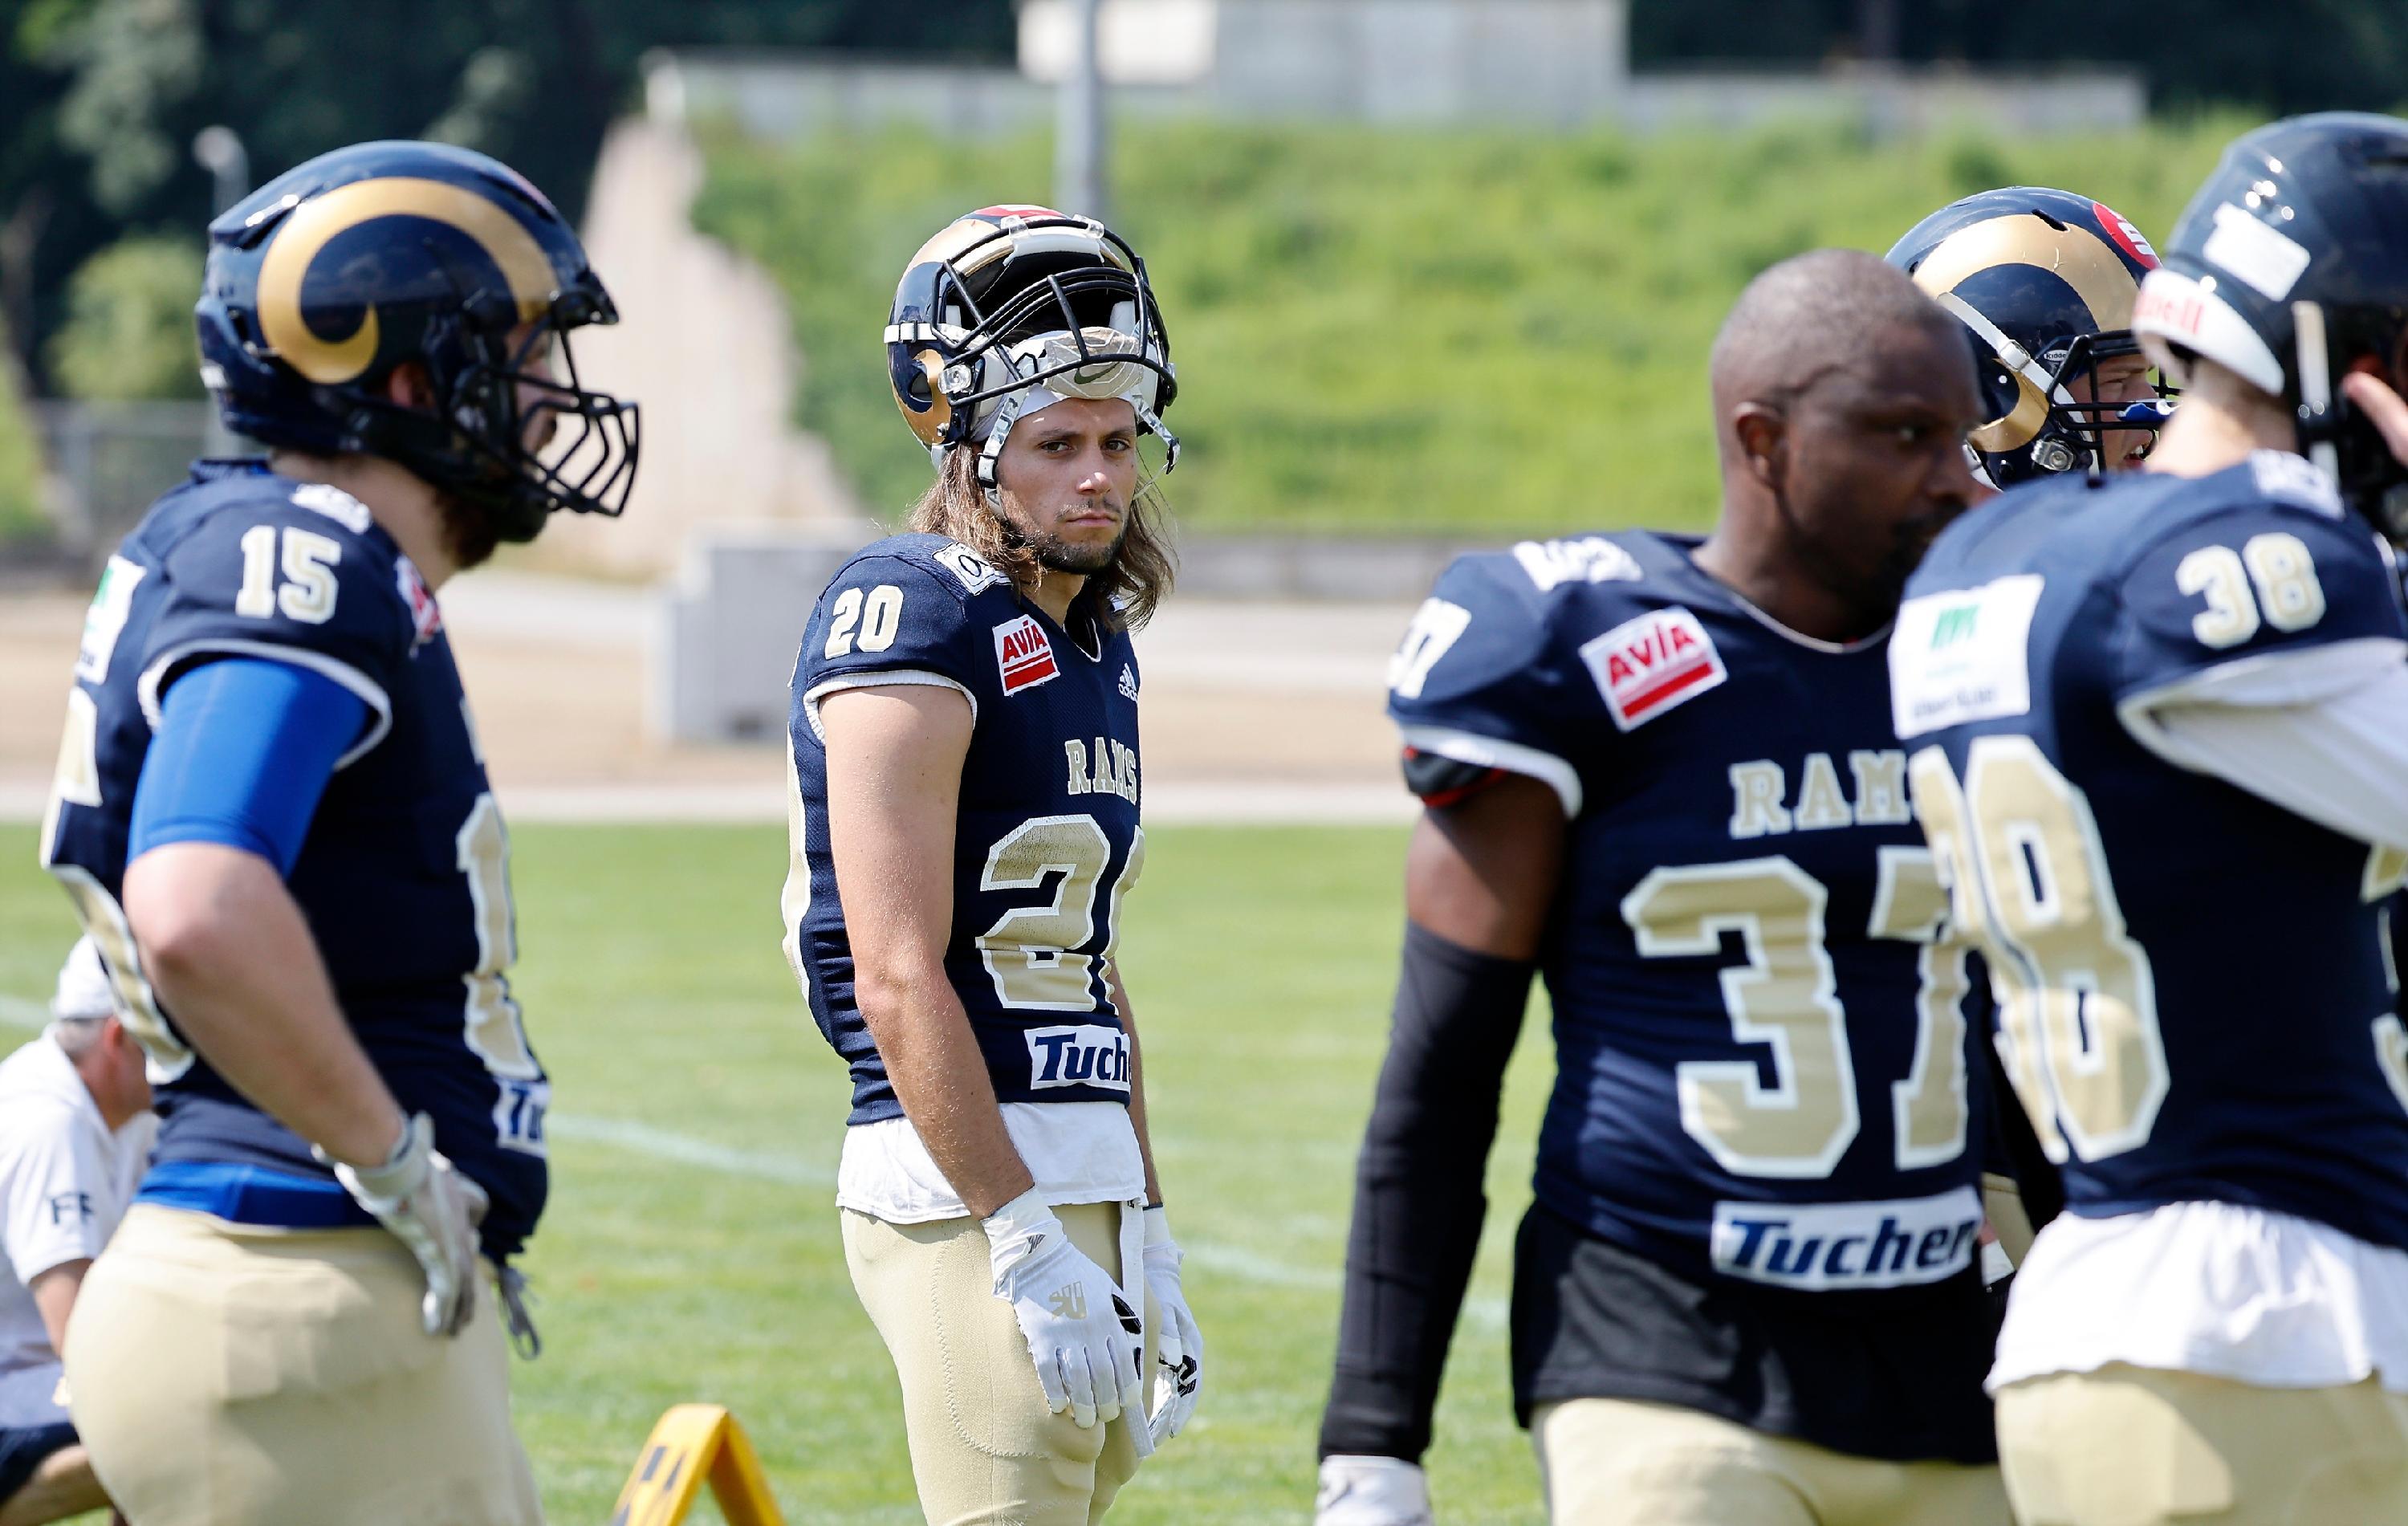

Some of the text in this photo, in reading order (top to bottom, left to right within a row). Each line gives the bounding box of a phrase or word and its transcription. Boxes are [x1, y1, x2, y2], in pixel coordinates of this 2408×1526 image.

[235, 526, 341, 624] 15
[2175, 531, 2327, 649] 38
[825, 584, 905, 660] 20
[1608, 621, 1696, 688] AVIA
[1064, 737, 1137, 805] RAMS
[1729, 749, 1915, 840] RAM
[1621, 846, 1971, 1180] 37
[1034, 1032, 1130, 1083] Tuch
[1729, 1216, 1977, 1279] Tucher
